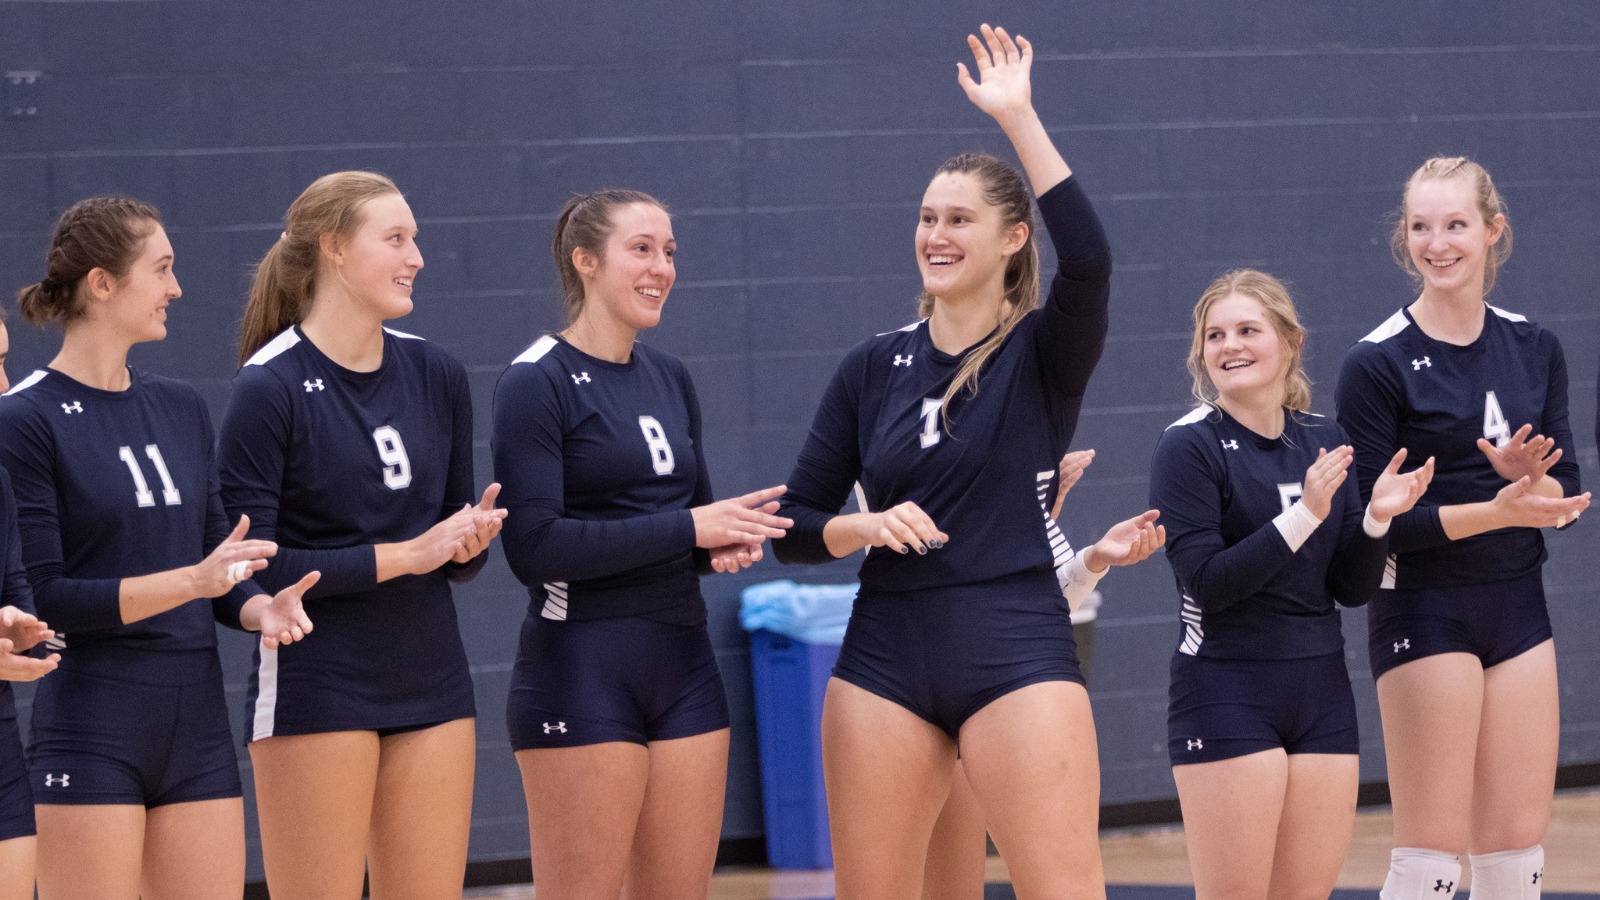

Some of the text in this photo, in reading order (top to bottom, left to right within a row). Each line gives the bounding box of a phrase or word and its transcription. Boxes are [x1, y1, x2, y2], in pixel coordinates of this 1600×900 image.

[638, 415, 675, 476] 8
[1483, 391, 1512, 449] 4
[119, 443, 182, 508] 11
[373, 425, 412, 490] 9
